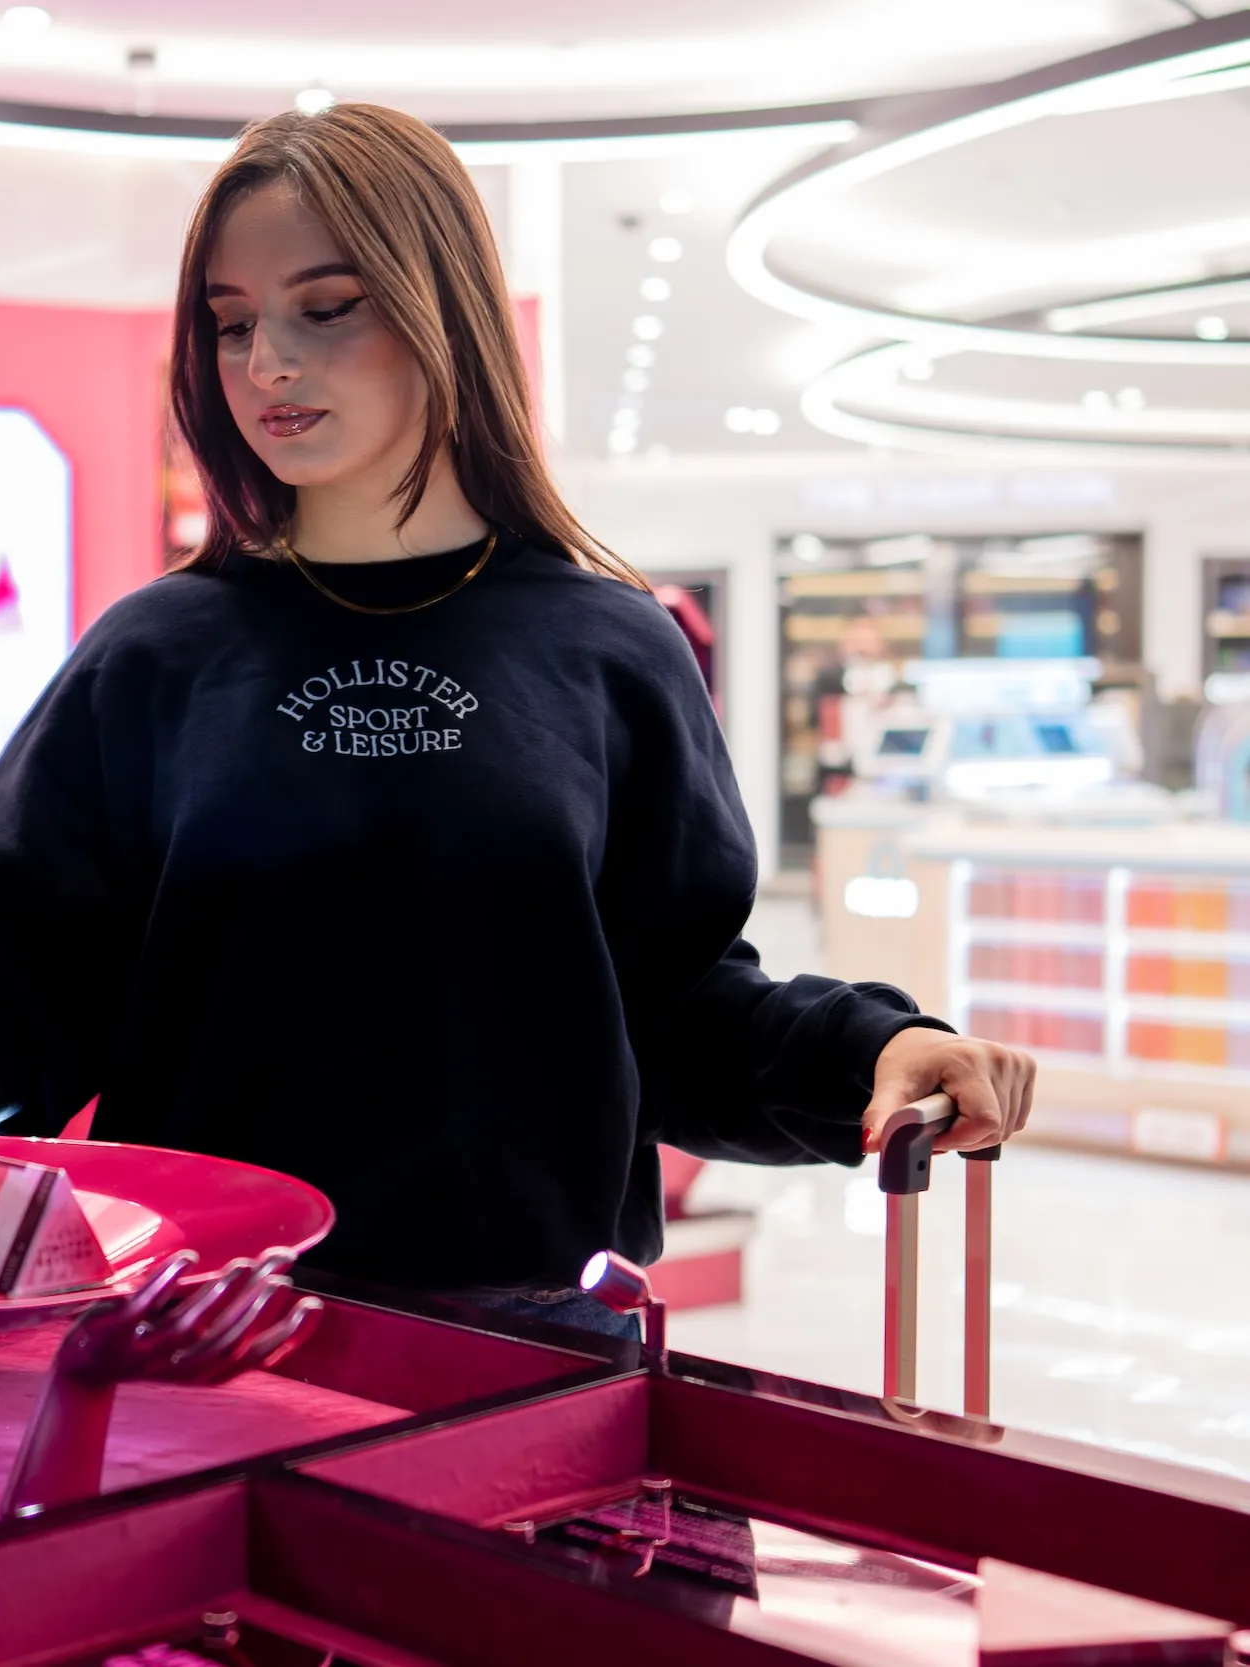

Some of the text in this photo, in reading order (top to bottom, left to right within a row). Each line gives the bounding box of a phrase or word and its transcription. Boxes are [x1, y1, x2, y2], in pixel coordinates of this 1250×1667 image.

[276, 658, 479, 722] HOLLISTER
[329, 704, 430, 732] SPORT
[301, 728, 463, 757] & LEISURE
